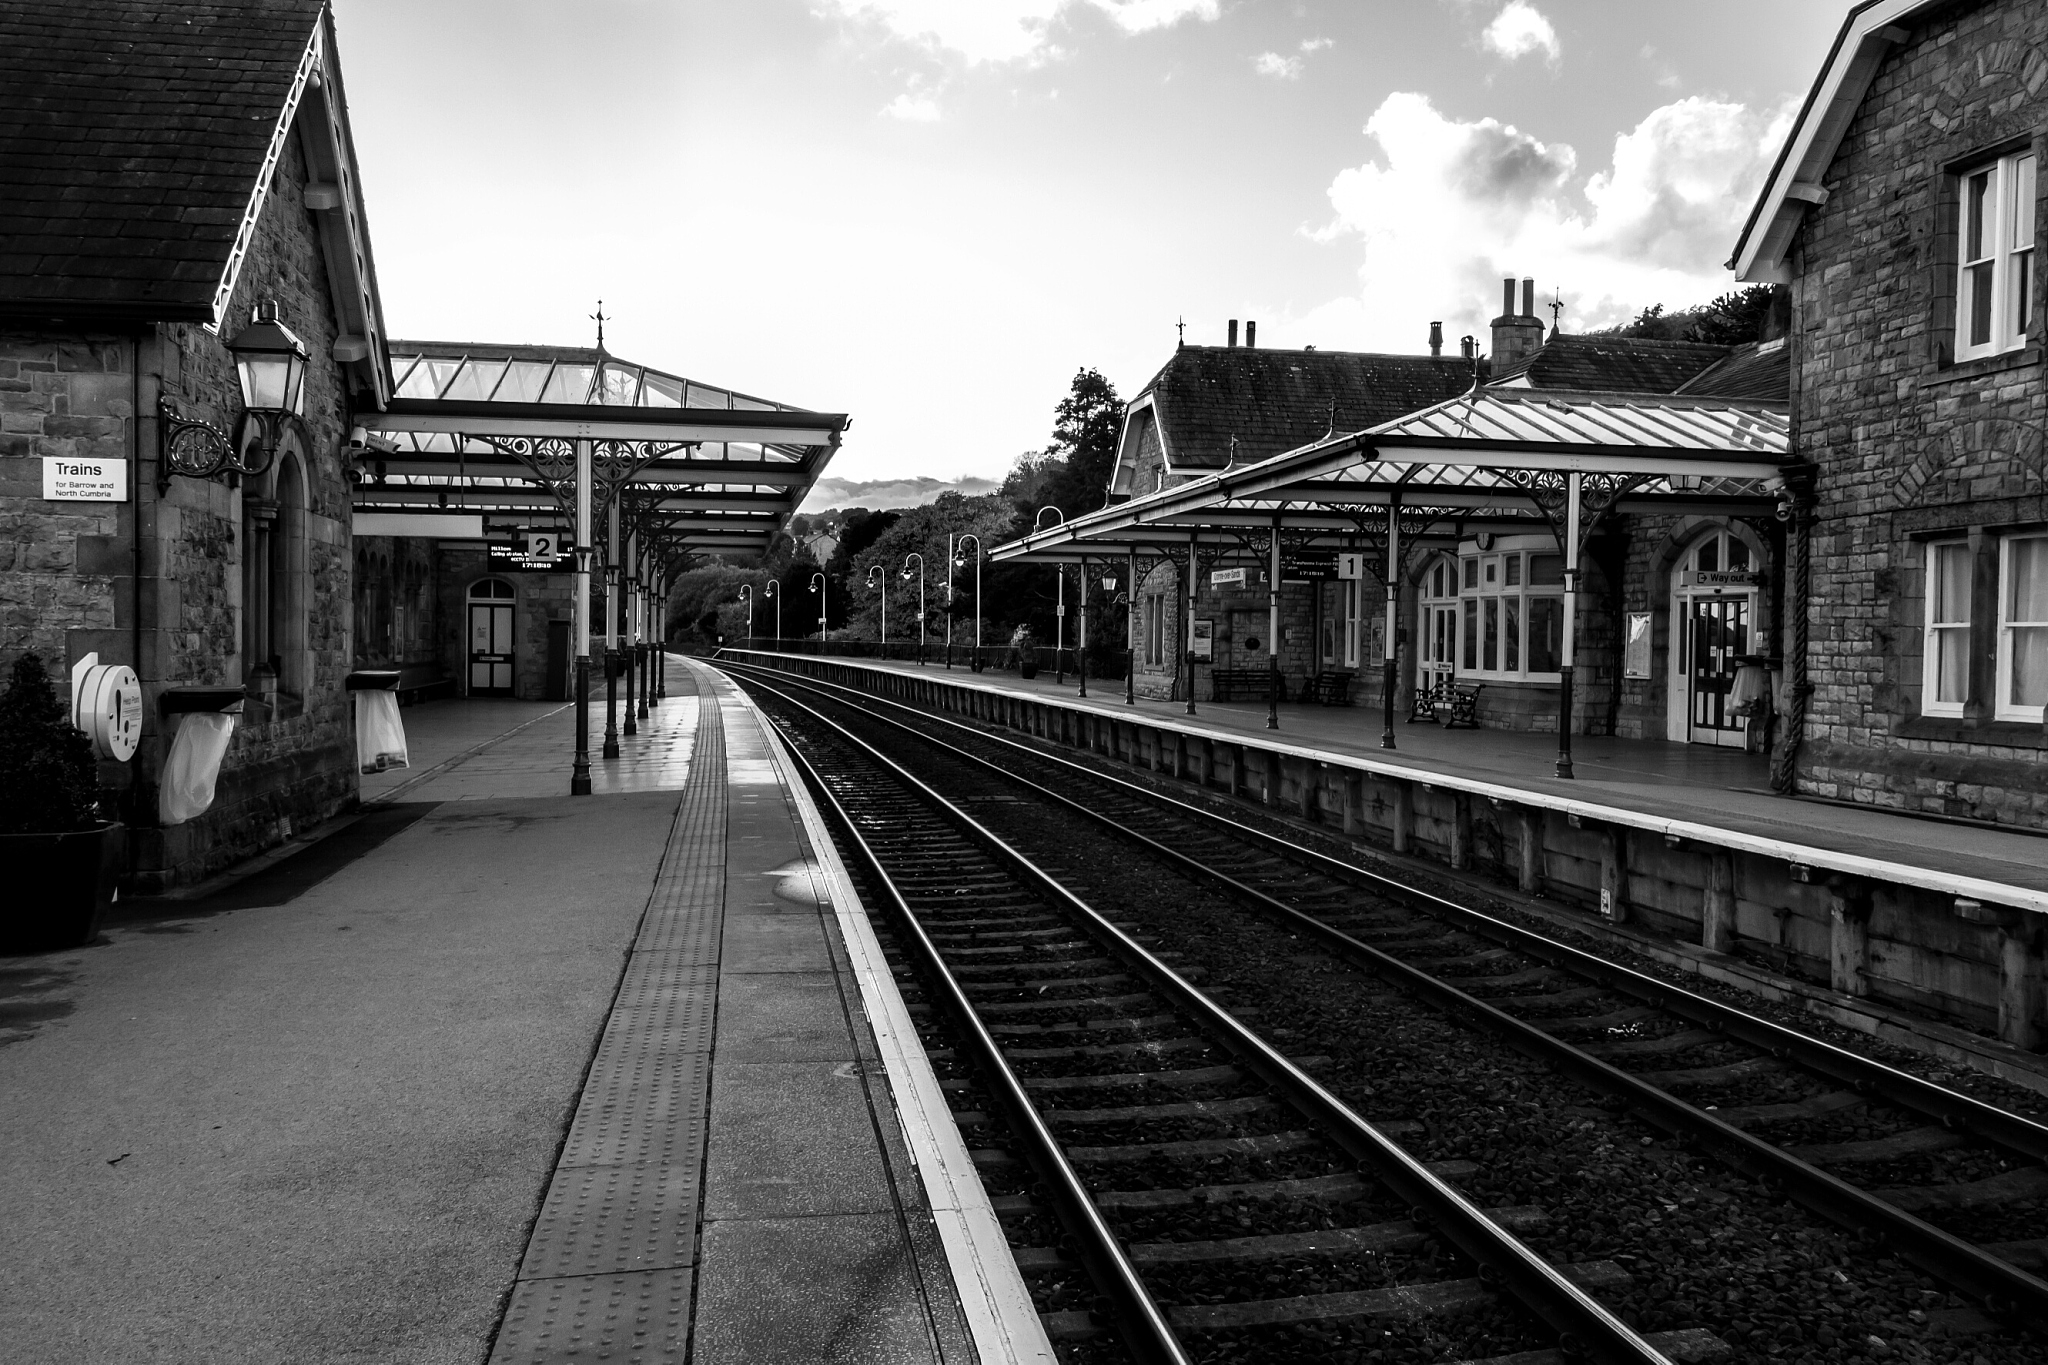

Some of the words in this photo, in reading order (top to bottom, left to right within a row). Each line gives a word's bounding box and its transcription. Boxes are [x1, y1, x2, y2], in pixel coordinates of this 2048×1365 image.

[55, 463, 102, 475] Trains
[535, 538, 550, 556] 2
[1347, 557, 1355, 575] 1
[1711, 573, 1729, 583] Way
[1730, 574, 1745, 582] out
